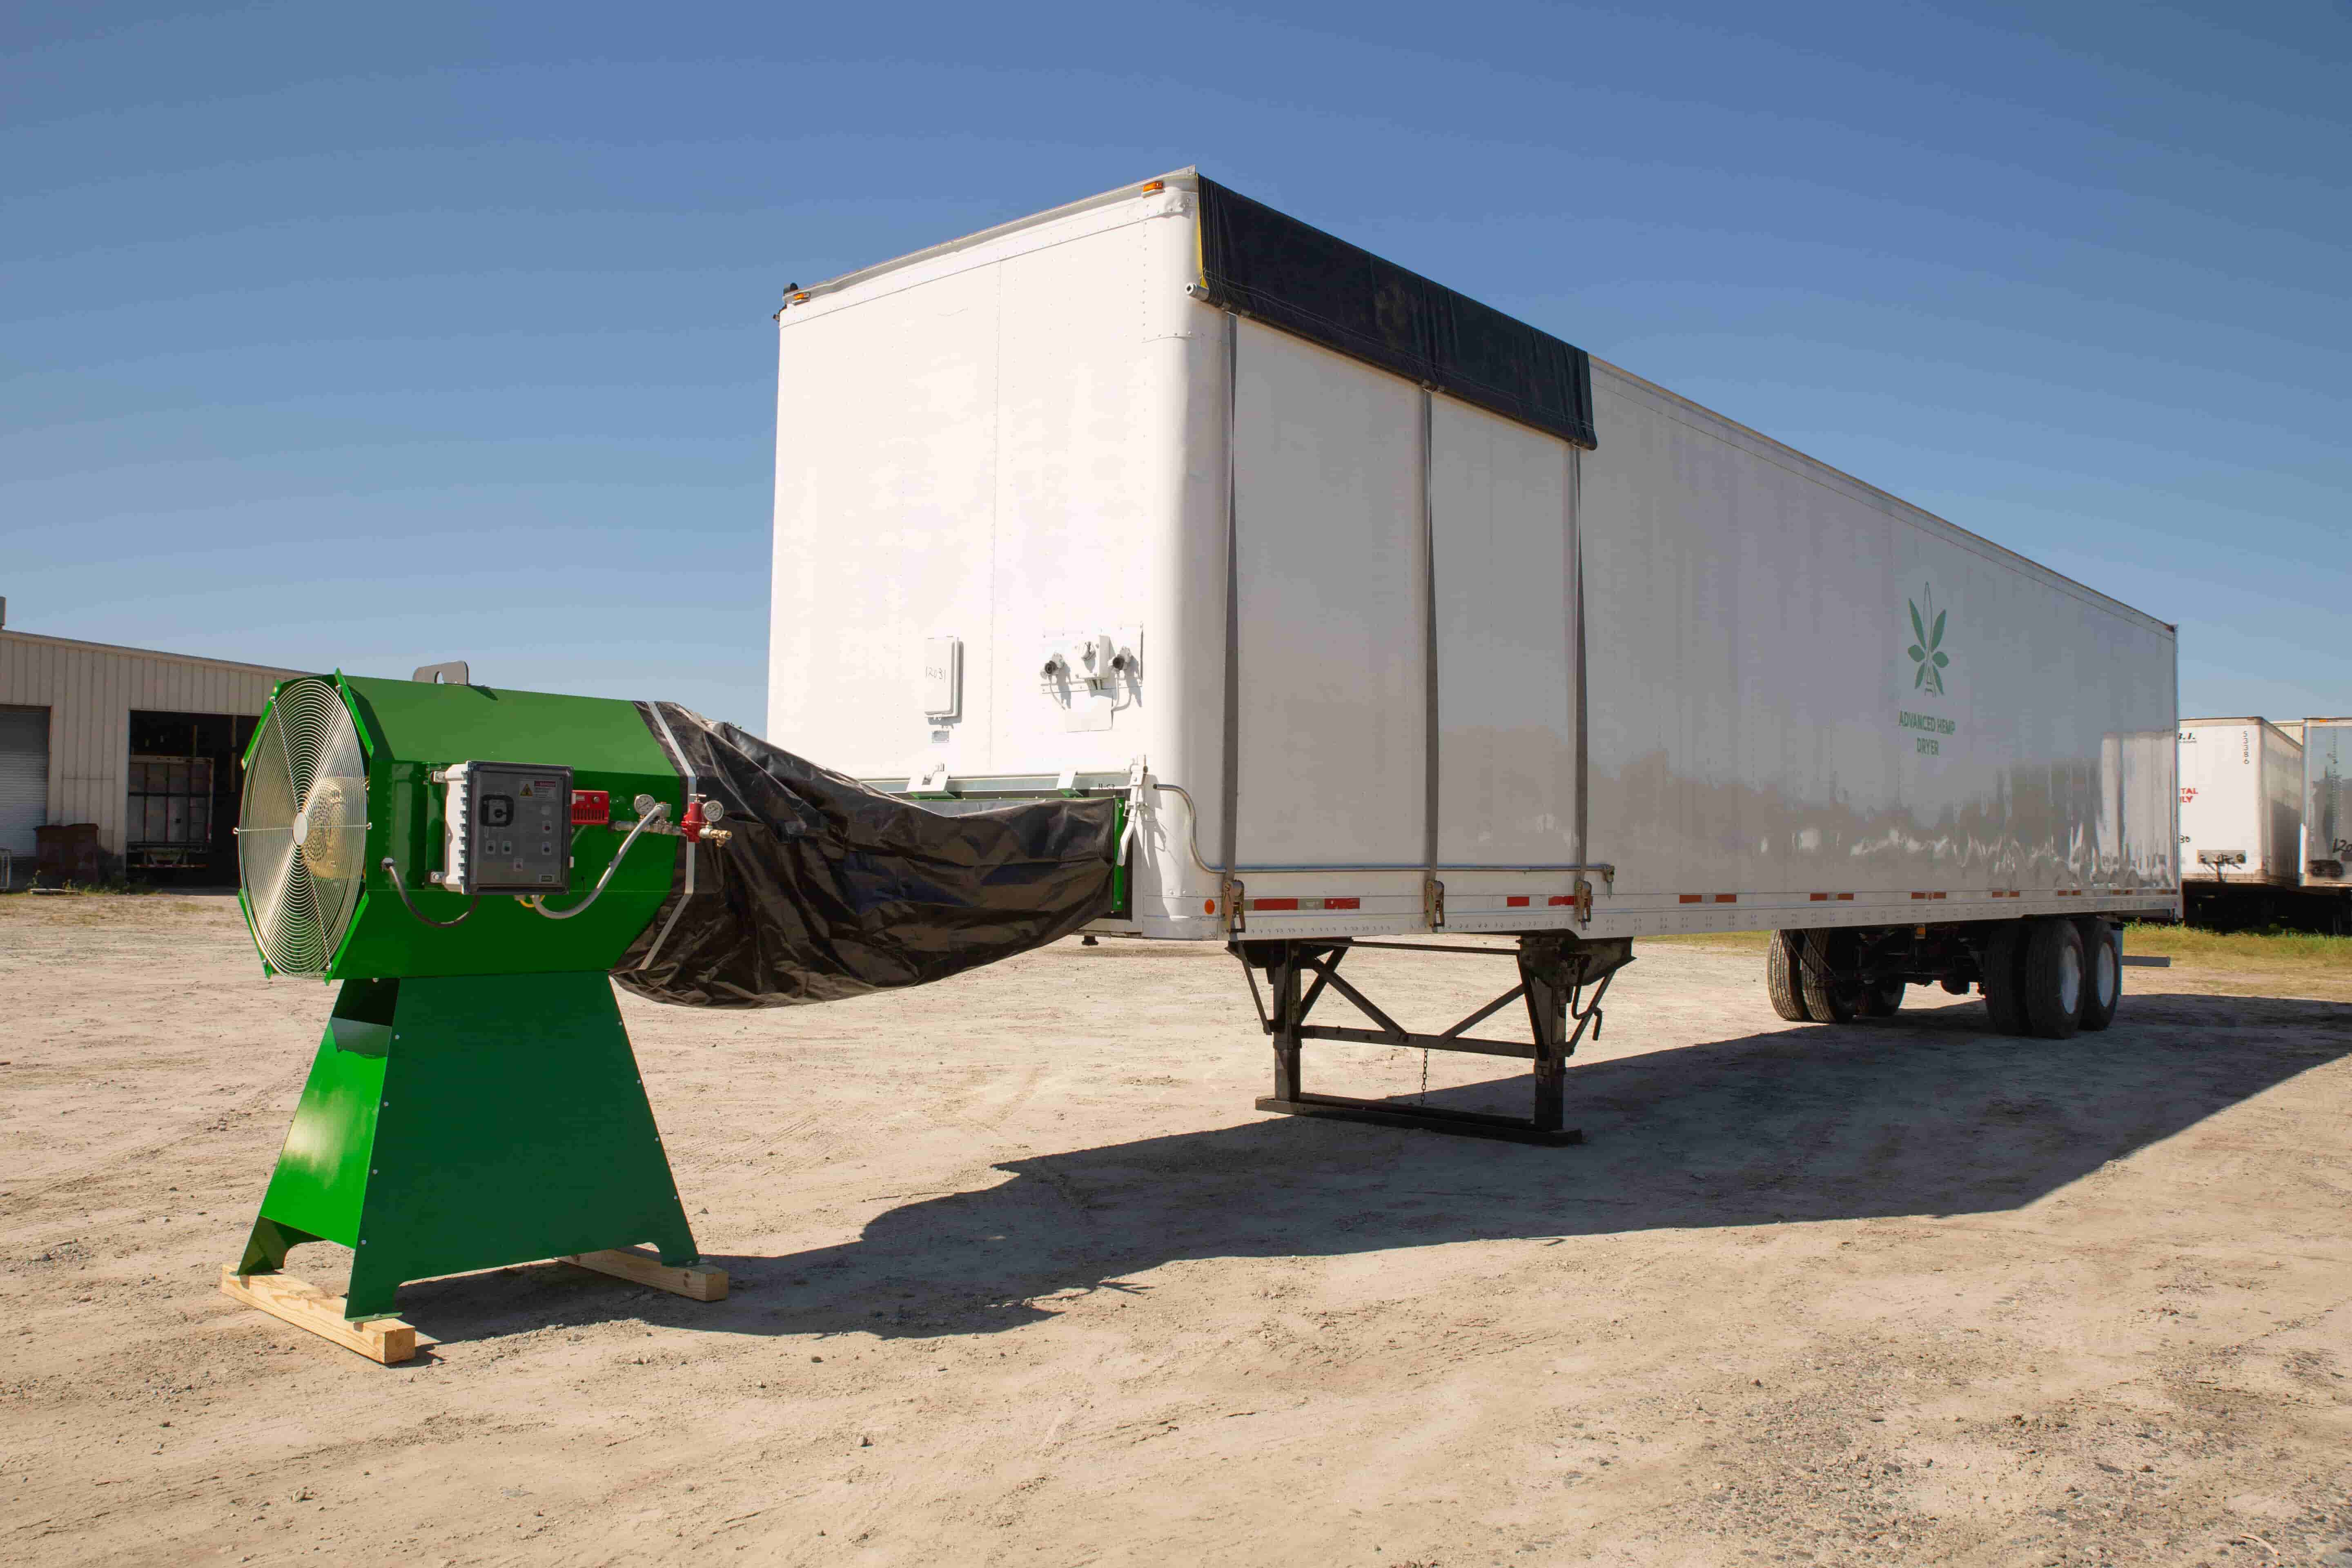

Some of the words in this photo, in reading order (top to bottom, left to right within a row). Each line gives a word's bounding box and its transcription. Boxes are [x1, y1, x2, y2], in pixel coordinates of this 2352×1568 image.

[1899, 710, 1935, 732] ADVANCED
[1937, 718, 1955, 735] HEMP
[1917, 737, 1940, 755] DRYER
